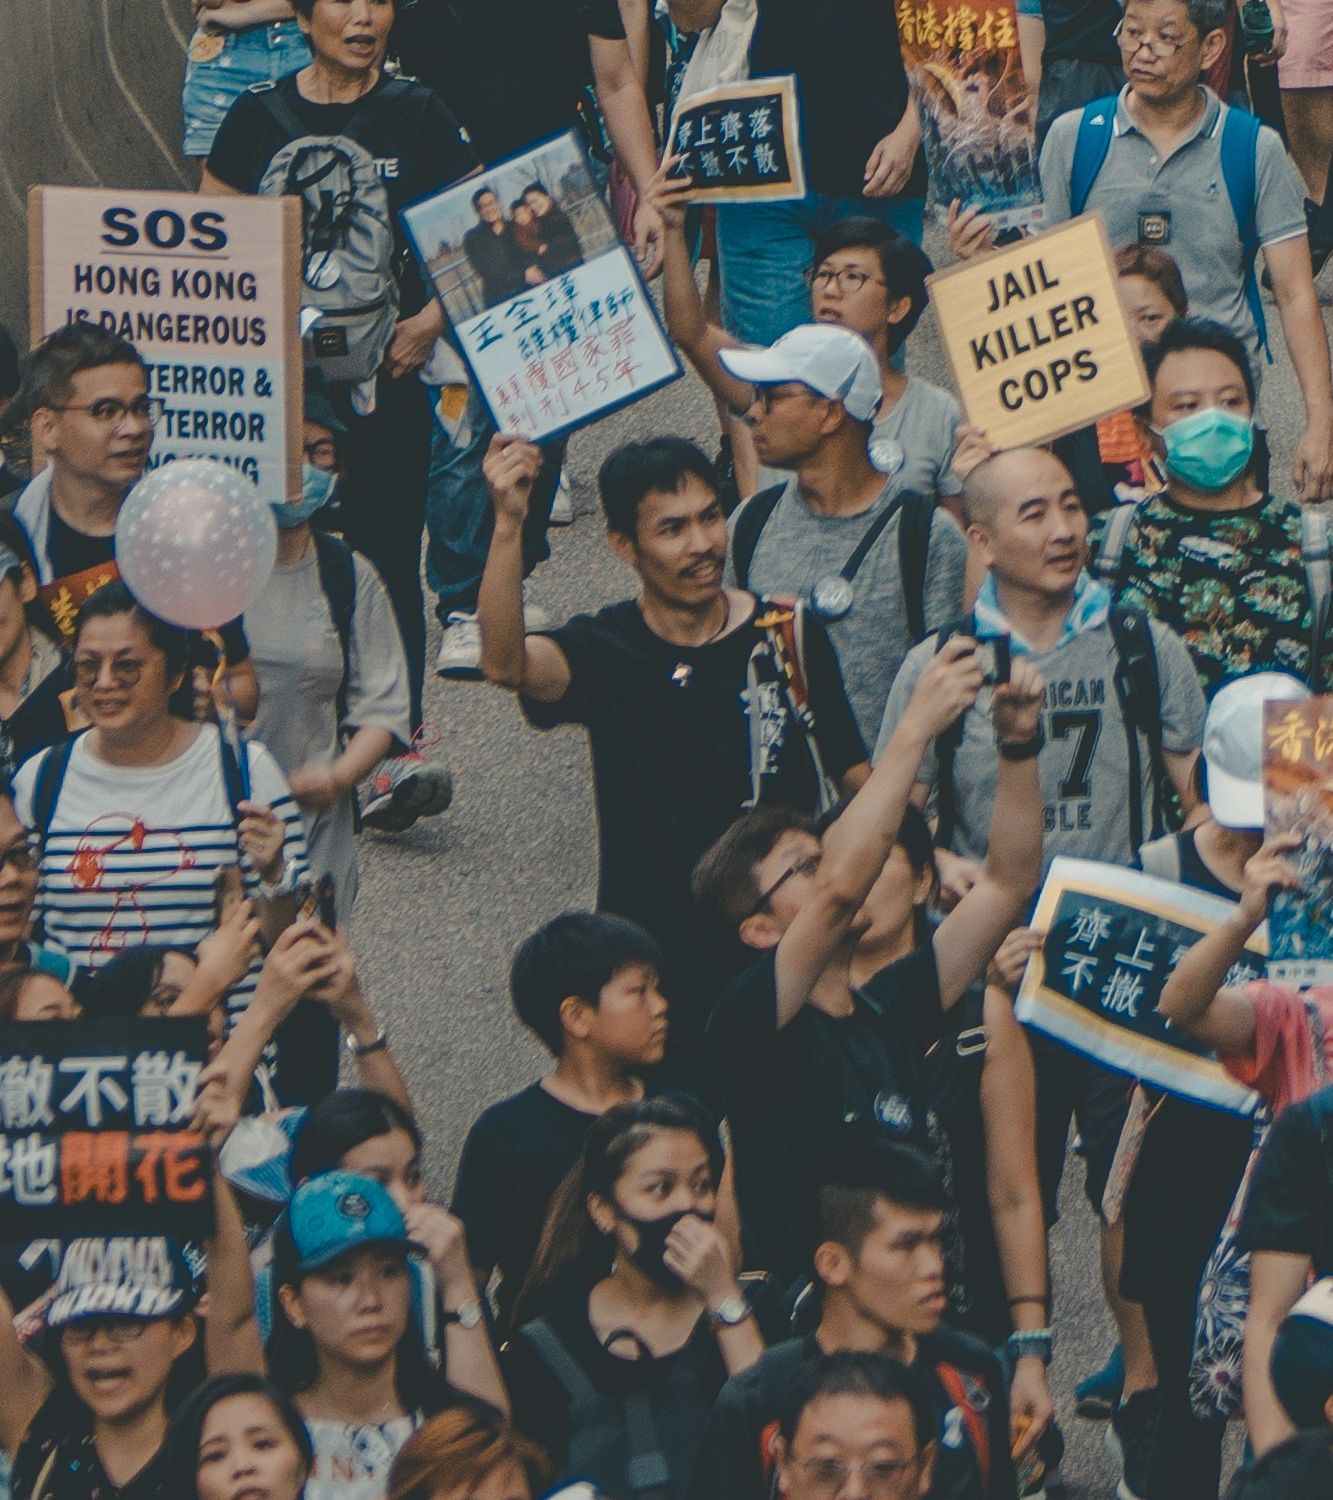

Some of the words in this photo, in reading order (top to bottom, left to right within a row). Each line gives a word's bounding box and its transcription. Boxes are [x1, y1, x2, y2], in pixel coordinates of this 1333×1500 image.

[899, 0, 1016, 53] 香港撐住
[101, 206, 229, 252] SOS
[74, 263, 158, 299] HONG
[171, 267, 258, 301] KONG
[985, 257, 1060, 314] JAIL
[98, 312, 267, 347] DANGEROUS
[968, 294, 1101, 373] KILLER
[146, 362, 248, 397] TERROR
[256, 365, 273, 399] &
[999, 348, 1099, 412] COPS
[164, 407, 266, 443] TERROR
